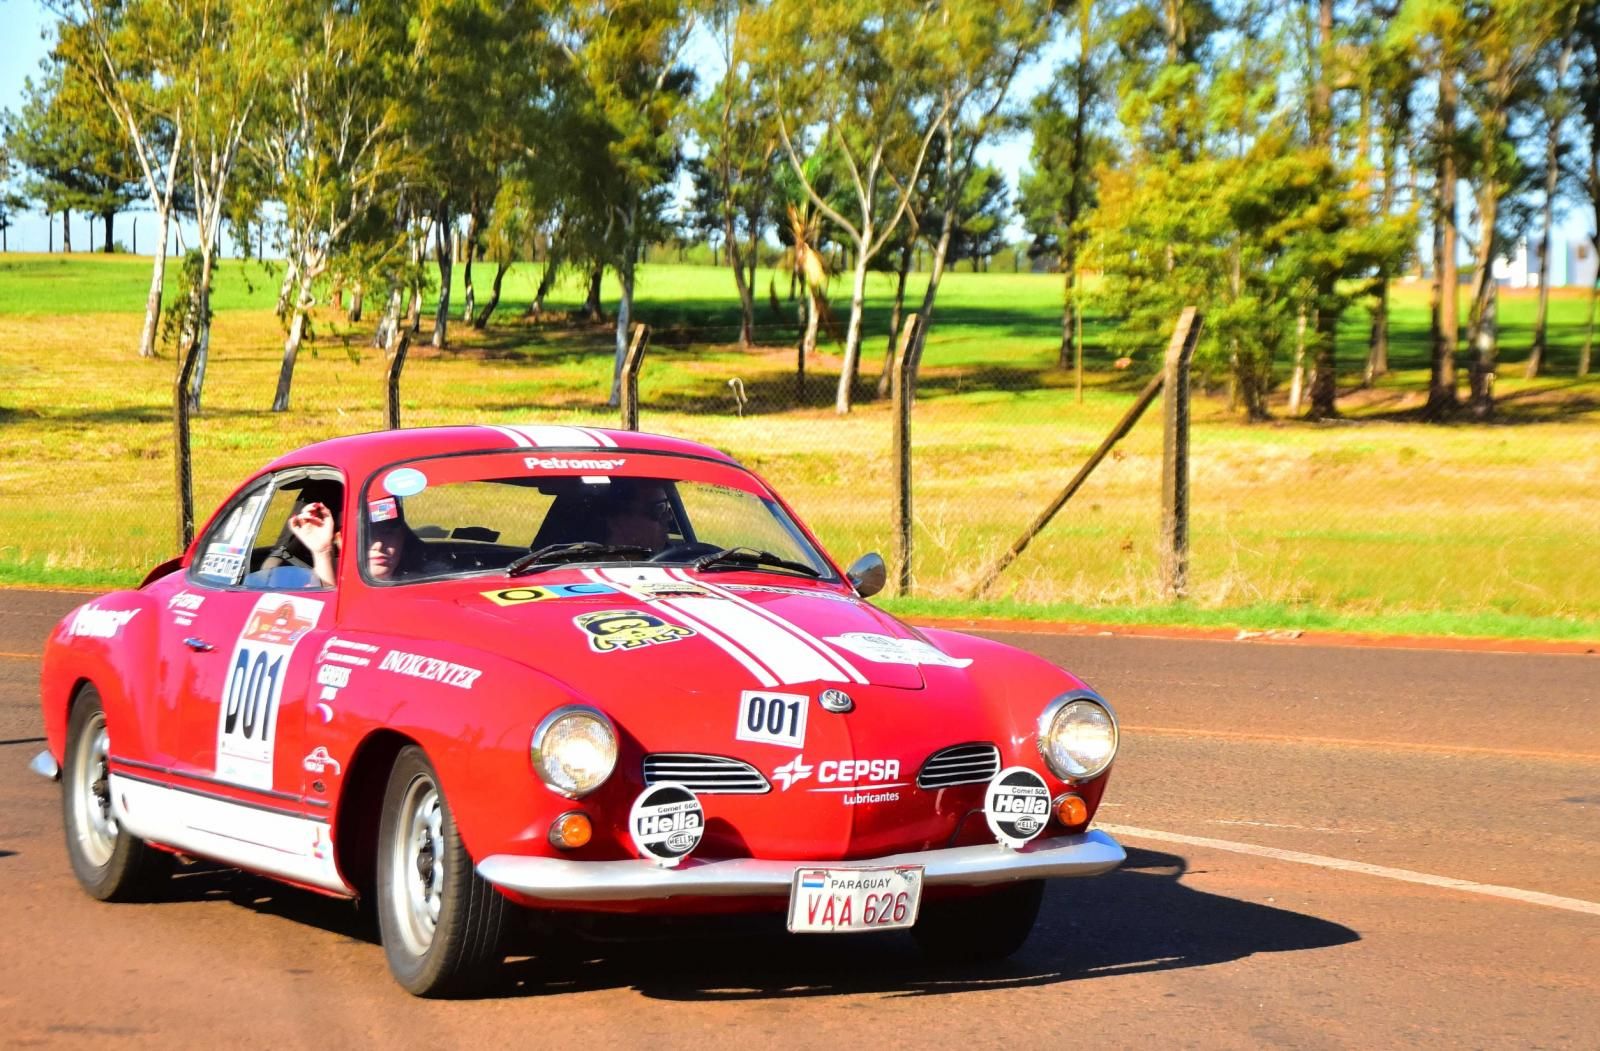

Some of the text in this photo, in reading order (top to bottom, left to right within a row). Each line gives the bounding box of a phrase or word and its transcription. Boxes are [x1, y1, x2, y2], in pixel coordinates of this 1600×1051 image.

[377, 649, 483, 690] INOXCENTER
[747, 696, 801, 738] 001
[817, 759, 900, 783] CEPSA
[843, 791, 900, 806] Lubricantes
[995, 794, 1047, 814] Hella
[639, 811, 700, 835] Hella
[1017, 820, 1038, 829] HELLA
[669, 834, 694, 844] HELLA
[830, 877, 892, 890] PARAGUAY
[807, 891, 909, 926] VAA 626
